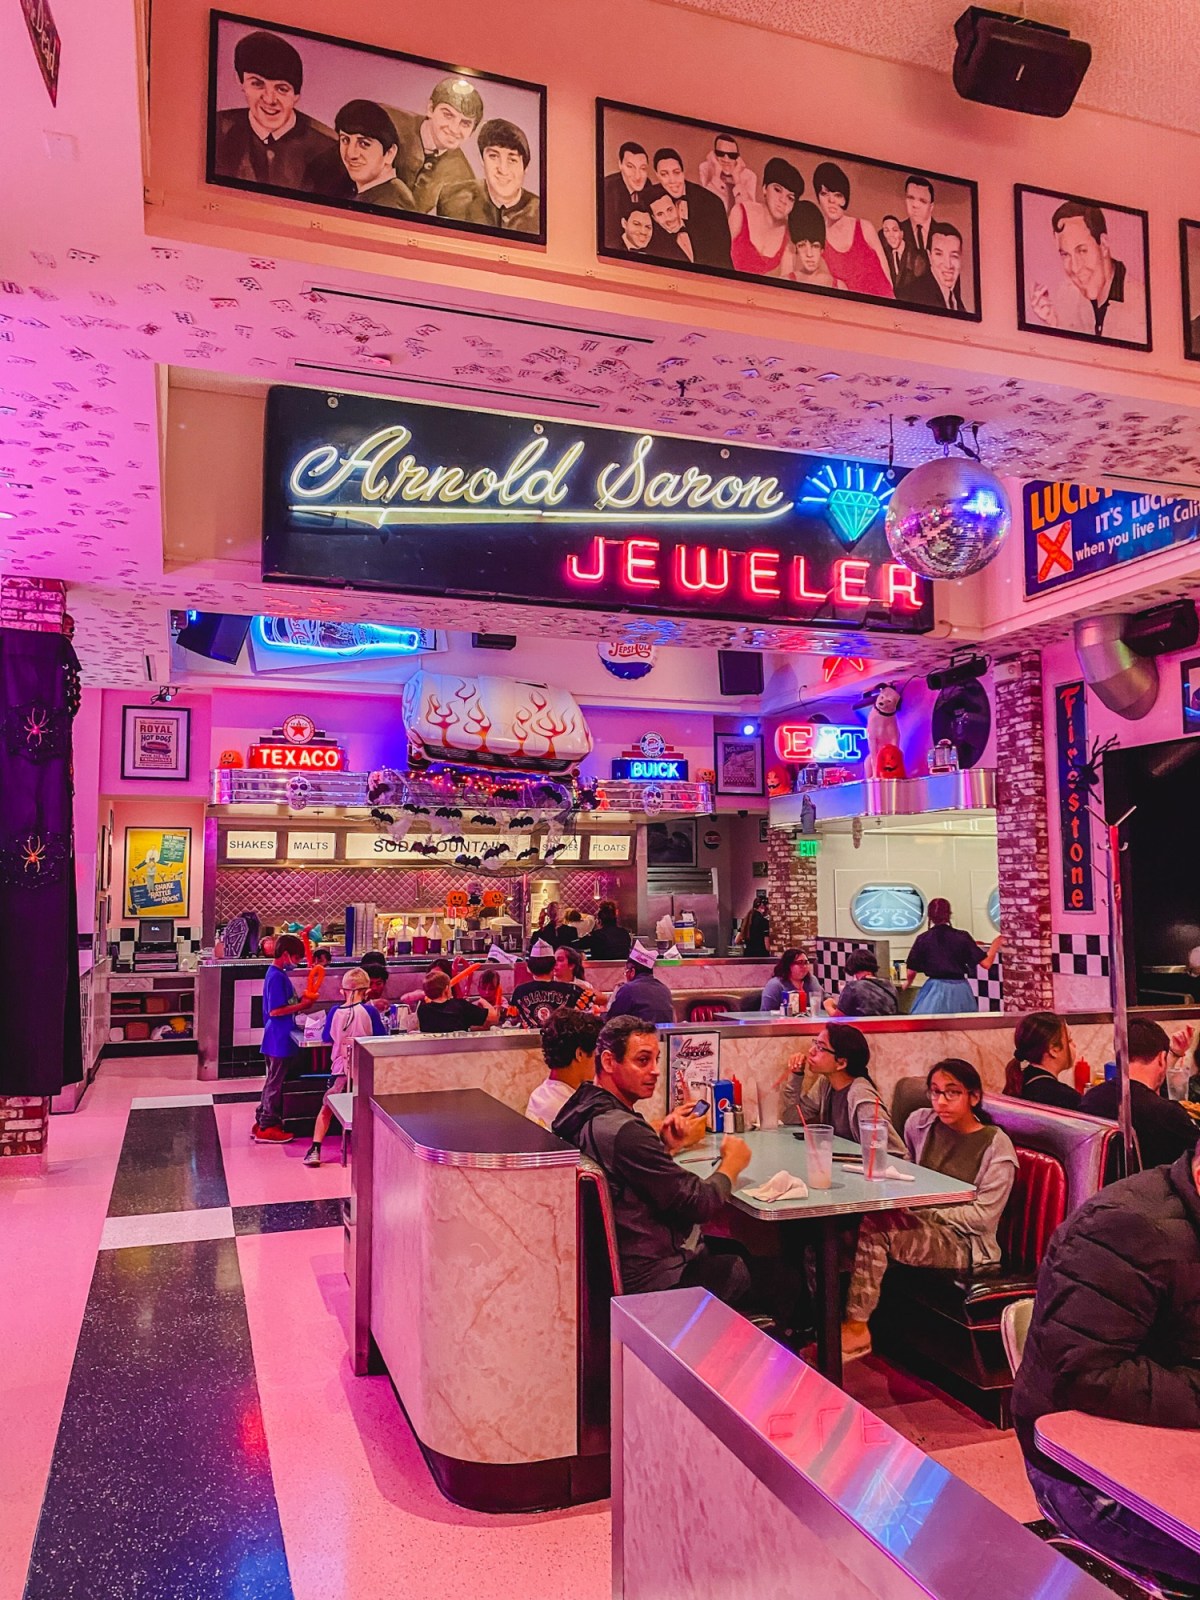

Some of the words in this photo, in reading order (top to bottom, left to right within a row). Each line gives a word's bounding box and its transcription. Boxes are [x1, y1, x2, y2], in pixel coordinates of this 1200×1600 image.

[289, 425, 585, 505] Arnold
[593, 434, 786, 511] Saron
[1031, 481, 1113, 531] LUCK
[1095, 507, 1123, 534] IT'S
[1075, 541, 1105, 561] when
[1108, 531, 1129, 554] you
[1132, 521, 1155, 540] live
[1158, 514, 1170, 530] in
[568, 536, 924, 610] JEWELER
[140, 725, 172, 734] ROYAL
[783, 726, 867, 759] EAT
[259, 748, 339, 767] TEXACO
[631, 762, 680, 777] BUICK
[229, 840, 274, 849] SHAKES
[293, 841, 329, 850] MALTS
[374, 840, 412, 853] SOD
[592, 844, 627, 852] FLOATS
[801, 841, 817, 856] EXIT
